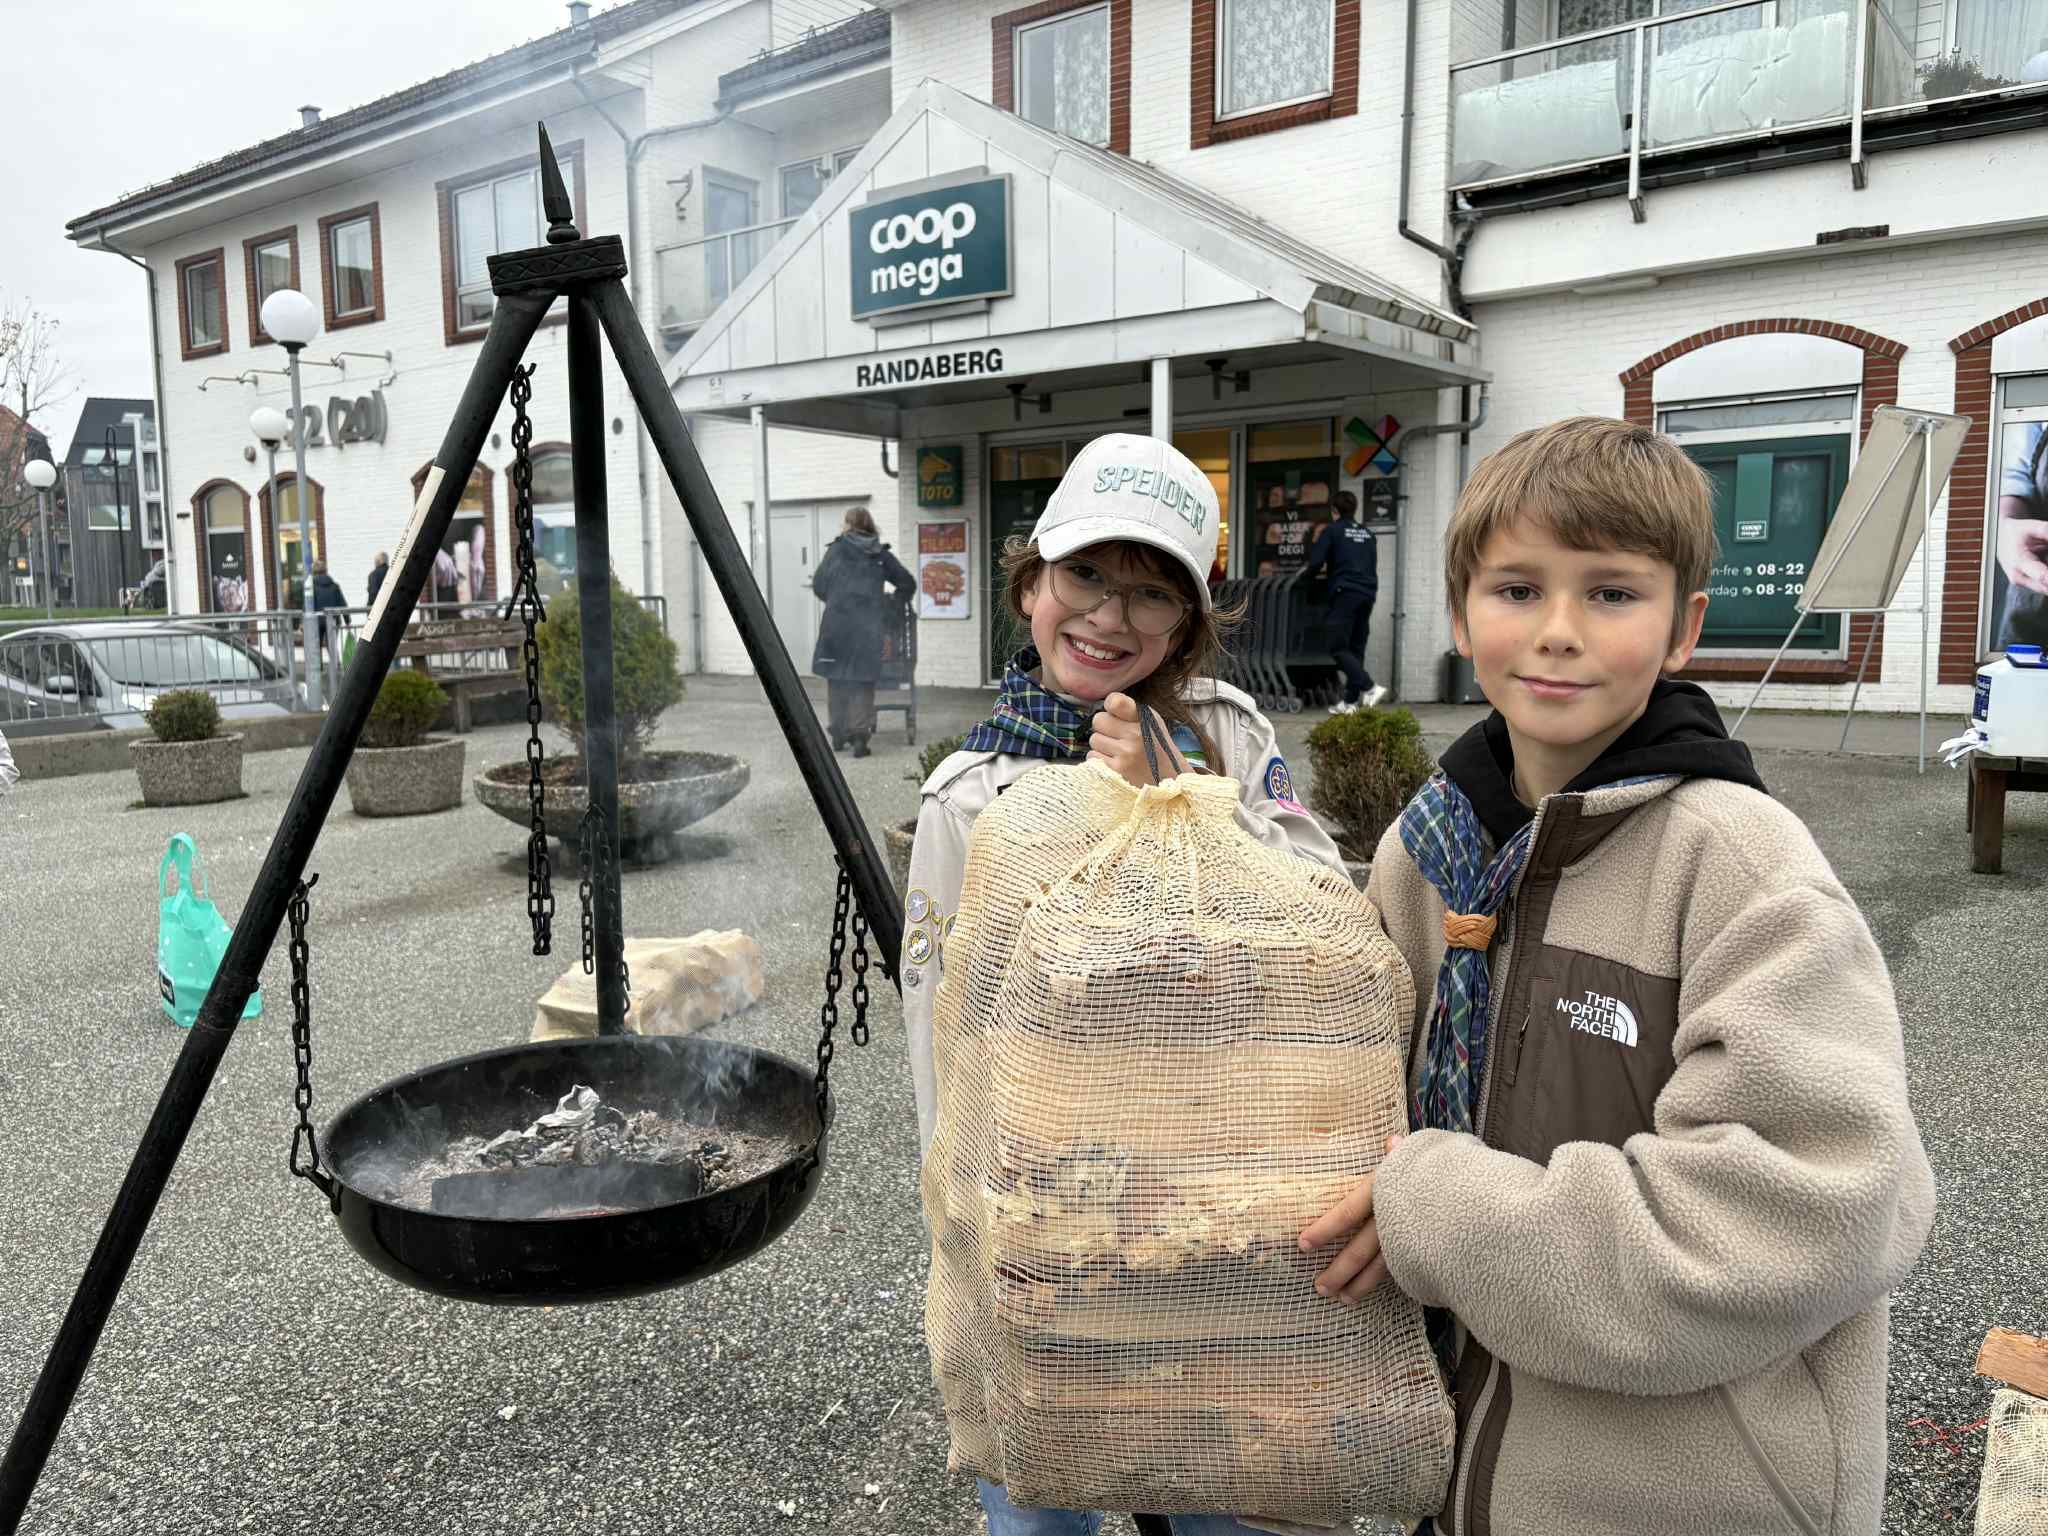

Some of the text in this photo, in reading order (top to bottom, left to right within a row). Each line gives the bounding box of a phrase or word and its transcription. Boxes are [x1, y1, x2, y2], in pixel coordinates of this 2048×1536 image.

[870, 202, 977, 253] coop
[871, 254, 963, 295] mega
[857, 348, 1003, 387] RANDABERG
[1093, 464, 1206, 535] SPEIDER
[1286, 511, 1299, 521] VI
[1278, 545, 1304, 555] DEG!
[1712, 564, 1739, 576] n-fre
[1556, 997, 1615, 1024] NORTH
[1585, 991, 1617, 1010] THE
[1570, 1016, 1612, 1037] FACE
